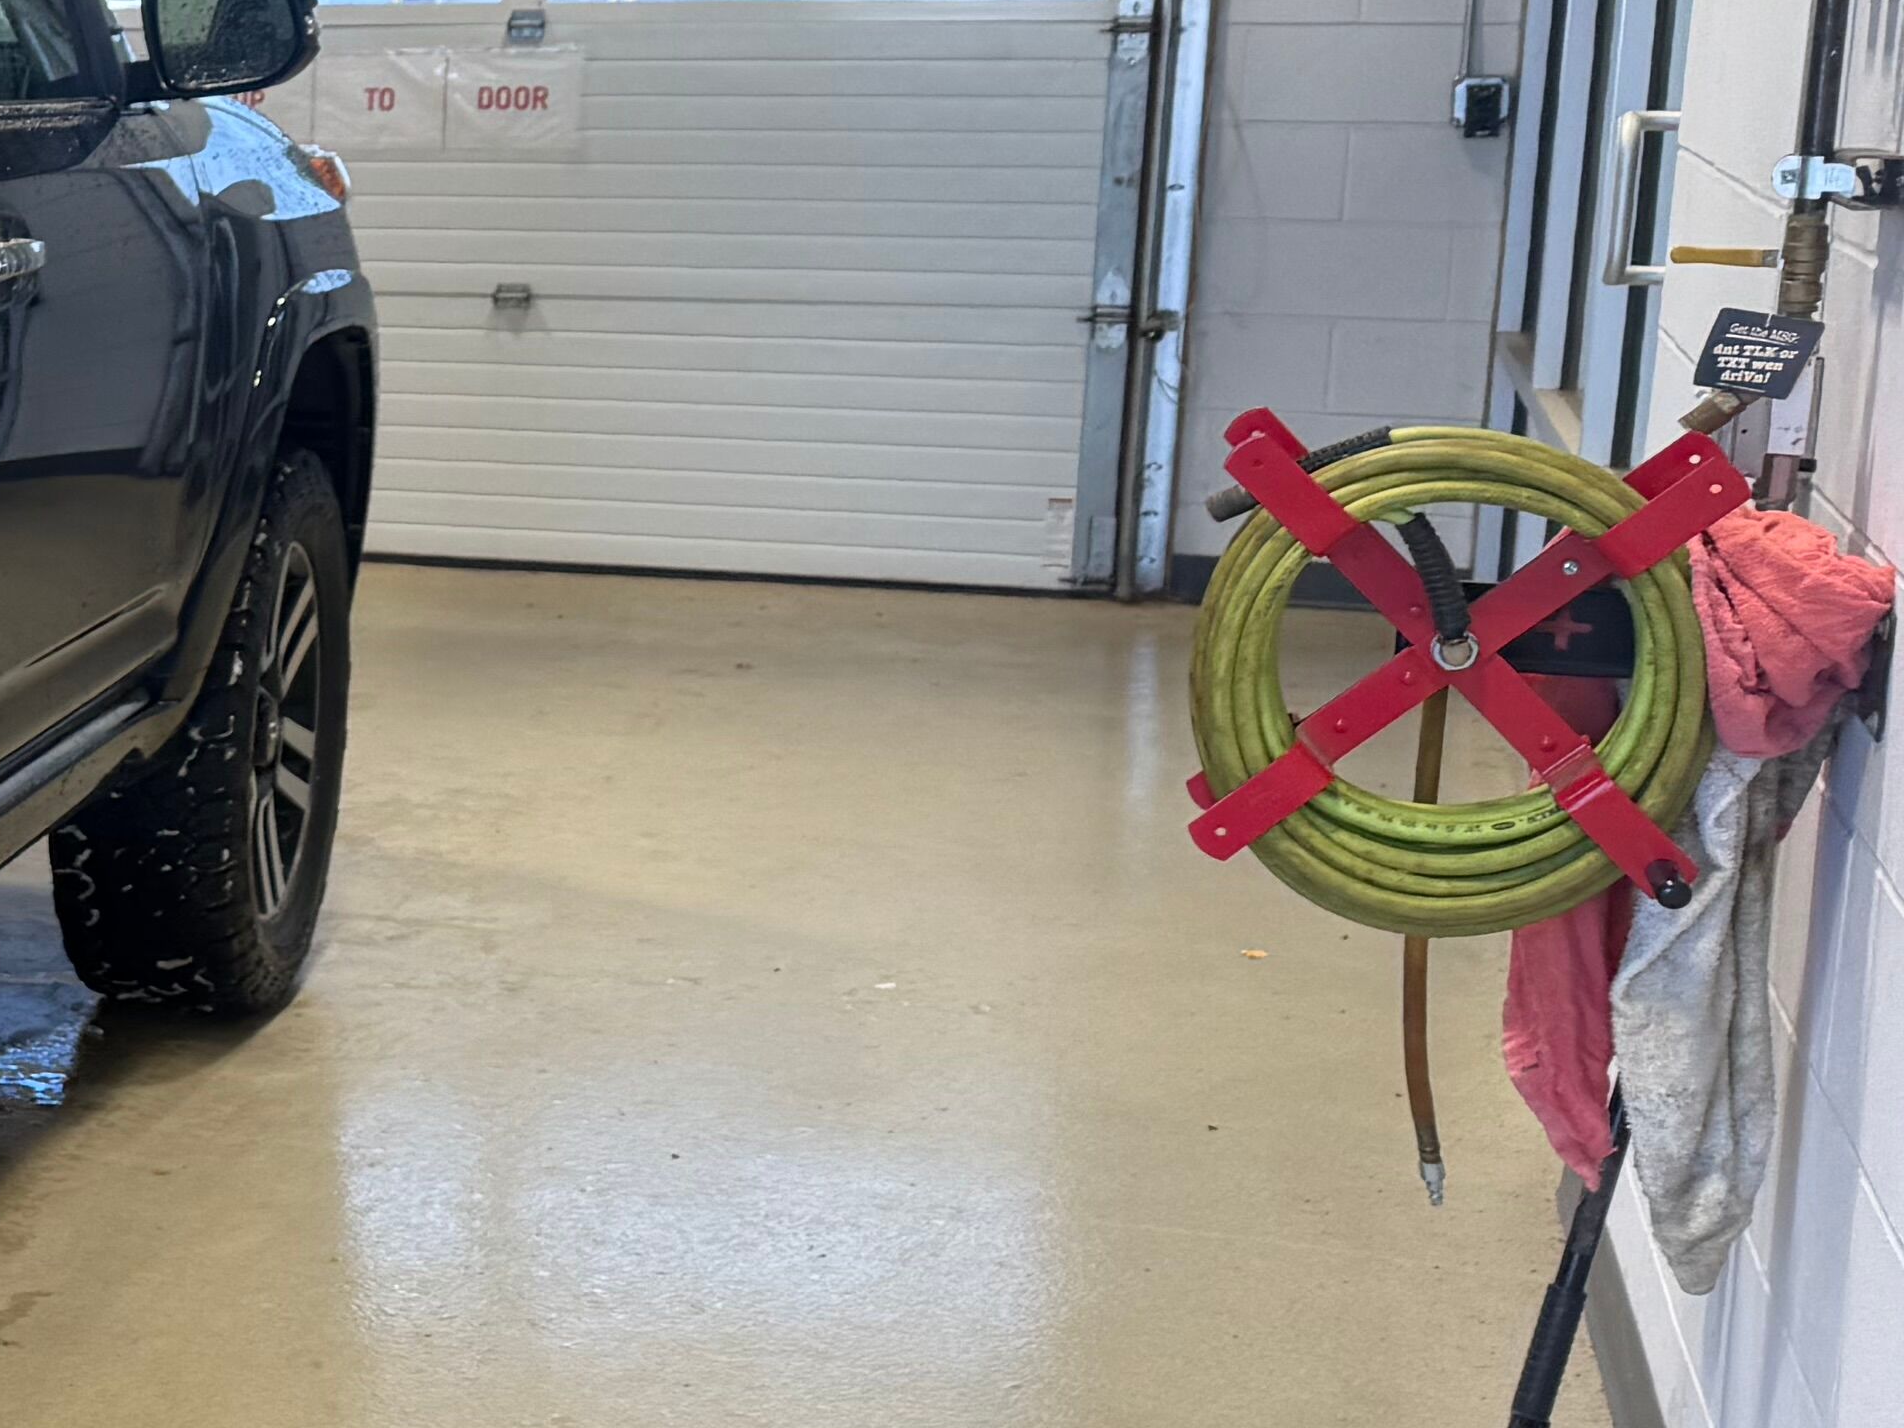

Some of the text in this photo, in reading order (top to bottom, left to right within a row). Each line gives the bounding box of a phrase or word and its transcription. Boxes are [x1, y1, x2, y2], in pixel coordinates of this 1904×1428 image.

[364, 87, 396, 112] TO
[477, 85, 551, 111] DOOR
[1729, 322, 1750, 335] Get
[1713, 343, 1800, 359] dnt TLK or
[1716, 356, 1784, 371] TXT wen
